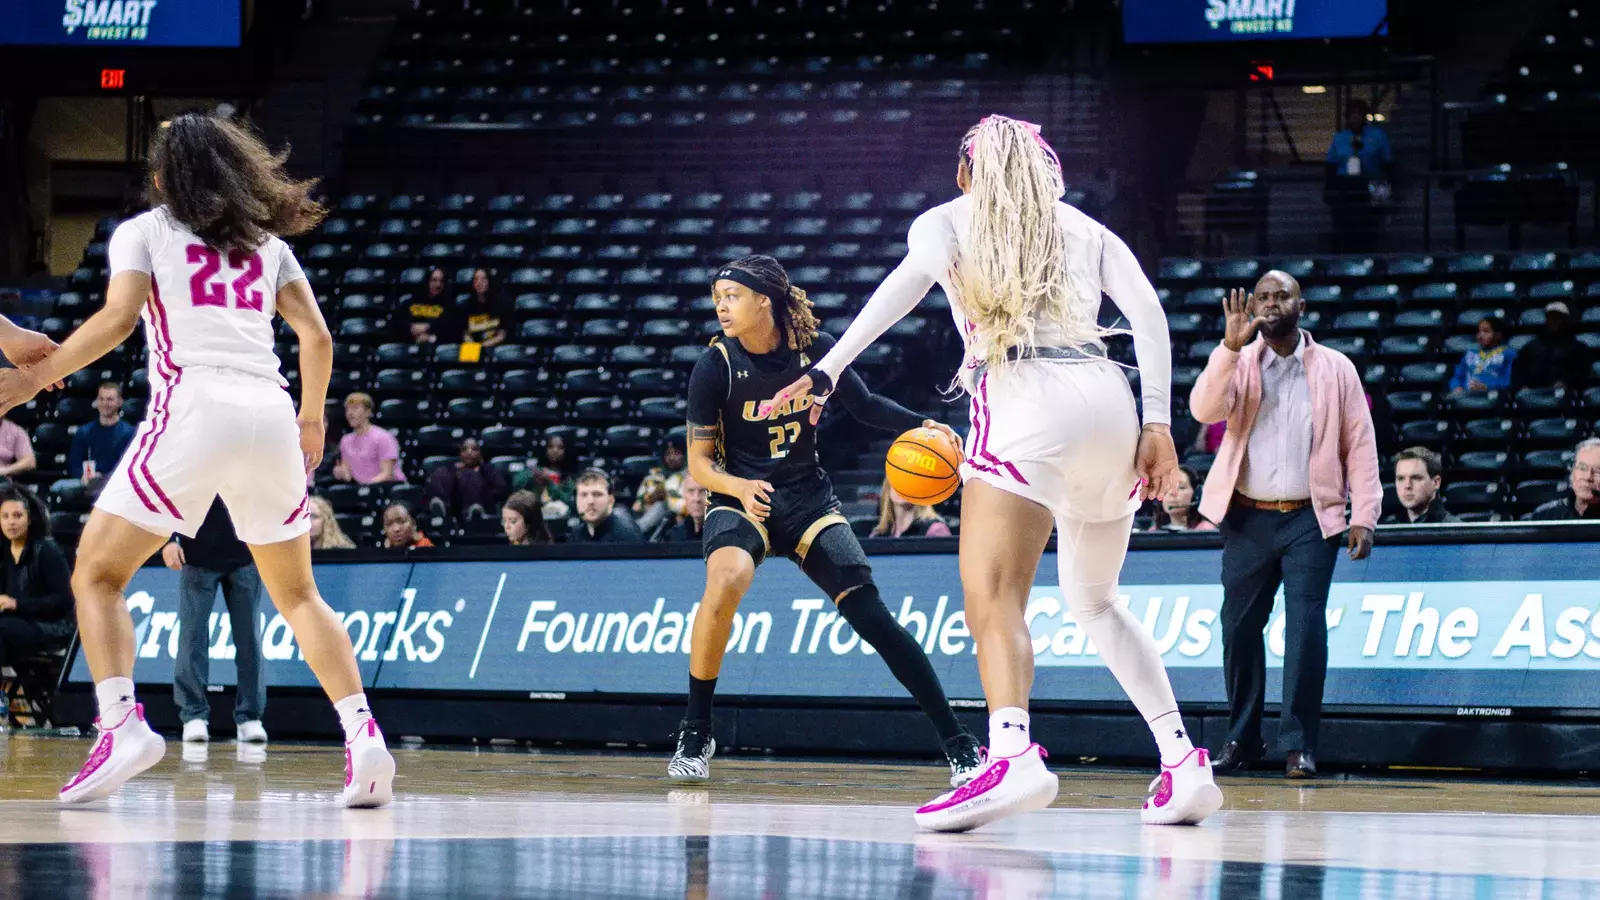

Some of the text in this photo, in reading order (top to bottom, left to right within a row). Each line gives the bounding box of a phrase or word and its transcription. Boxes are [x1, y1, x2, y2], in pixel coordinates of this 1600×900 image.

[101, 68, 125, 89] EXIT
[185, 243, 264, 313] 22
[516, 598, 773, 654] Foundaton
[1361, 592, 1479, 659] The
[1457, 707, 1512, 716] DAKTRONICS
